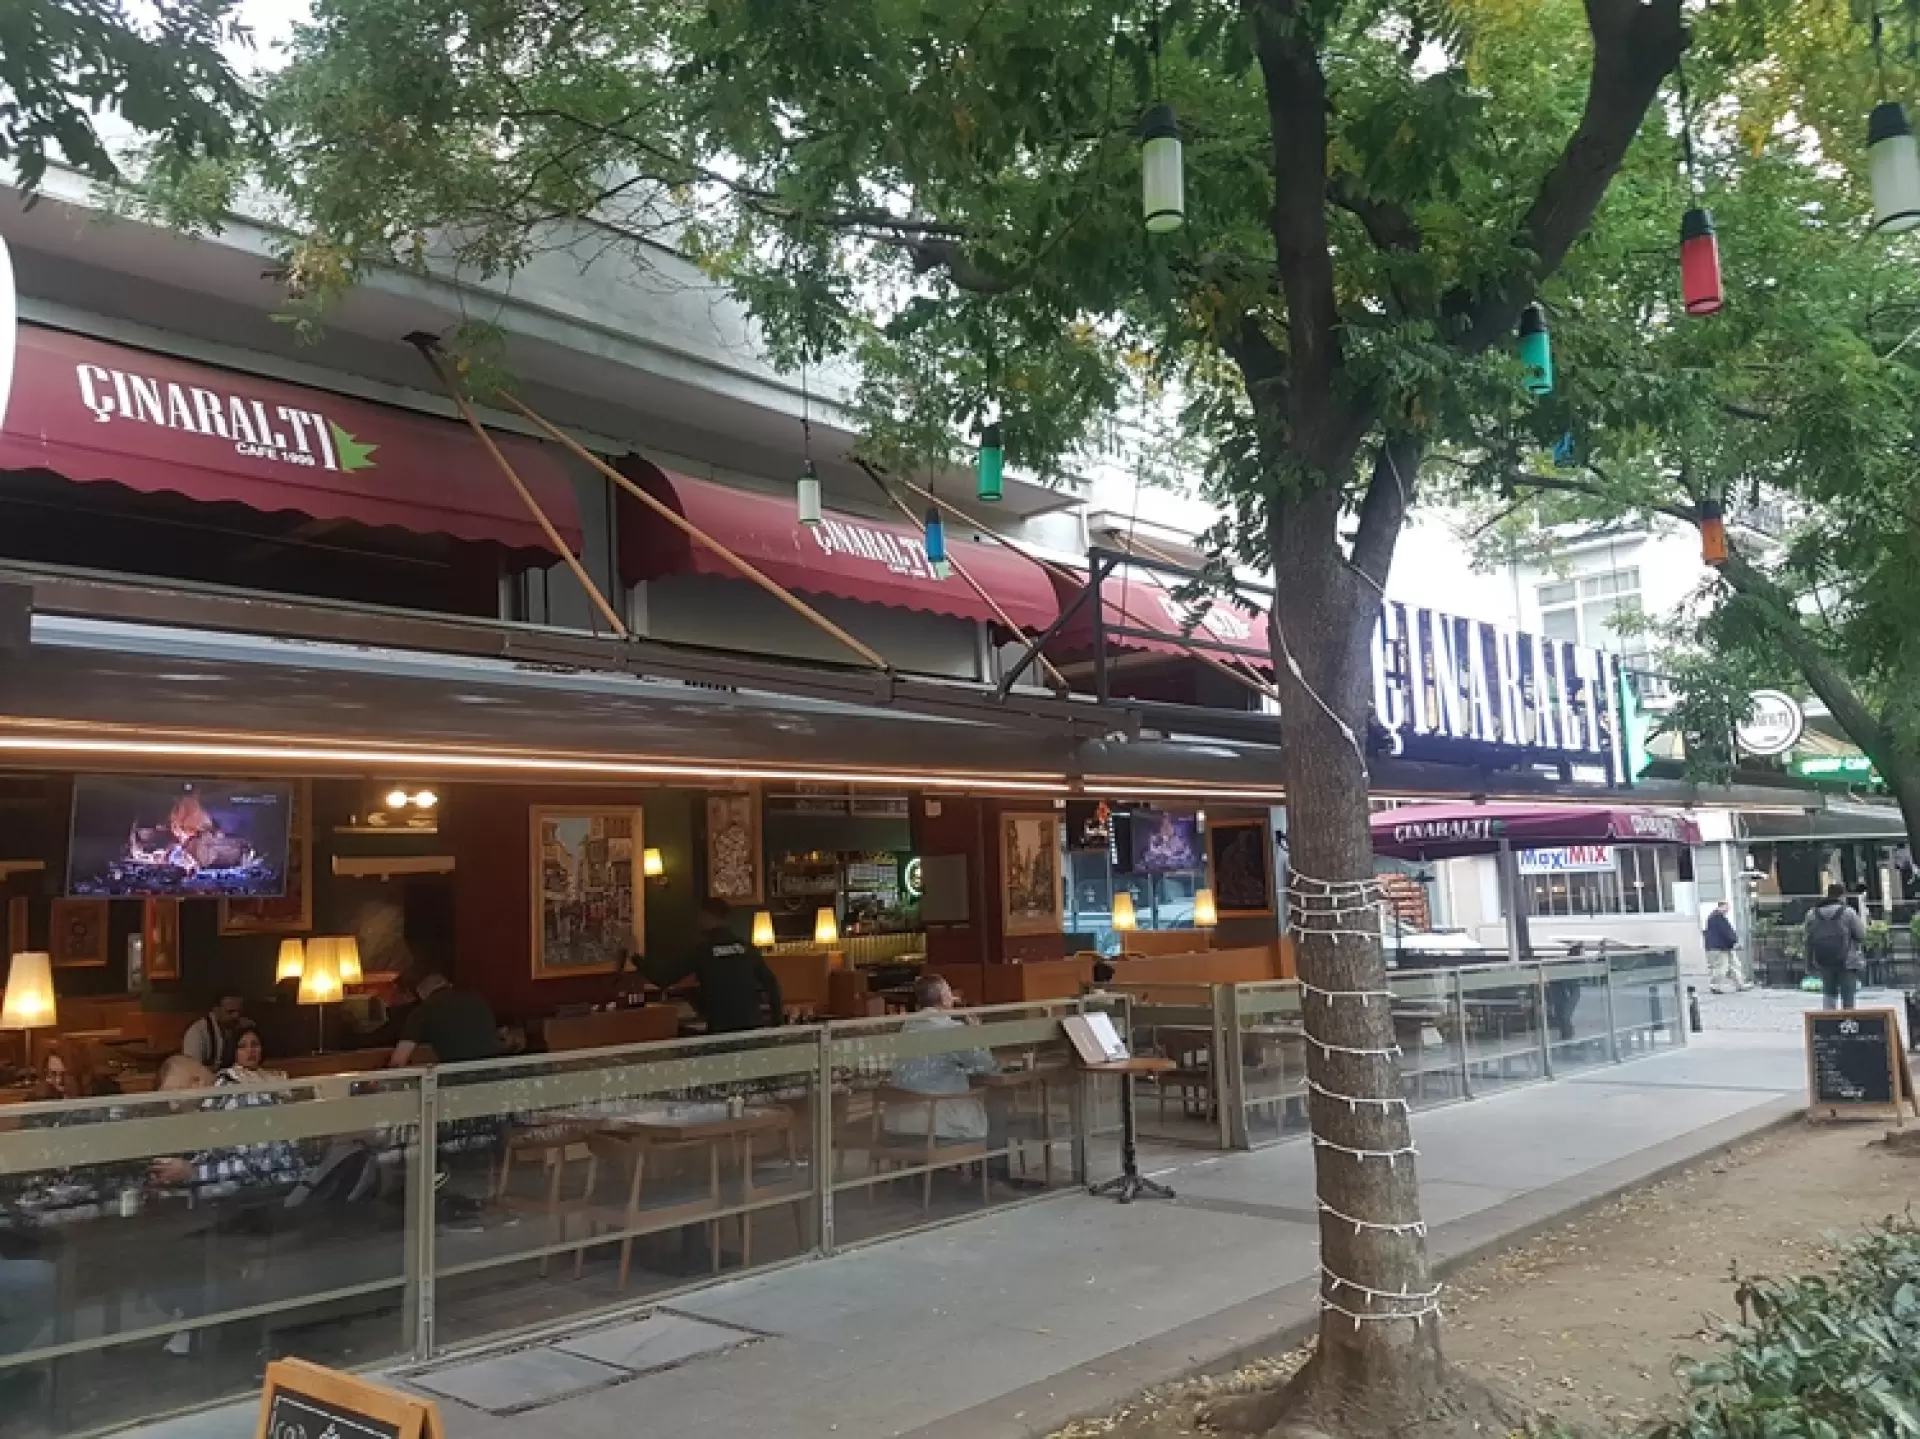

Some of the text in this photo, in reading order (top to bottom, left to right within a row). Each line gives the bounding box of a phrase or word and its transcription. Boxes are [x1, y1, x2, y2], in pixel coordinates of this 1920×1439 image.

[76, 363, 338, 471] ÇINARALTI
[235, 441, 278, 461] CAFE
[1369, 600, 1626, 783] ÇINARALTI
